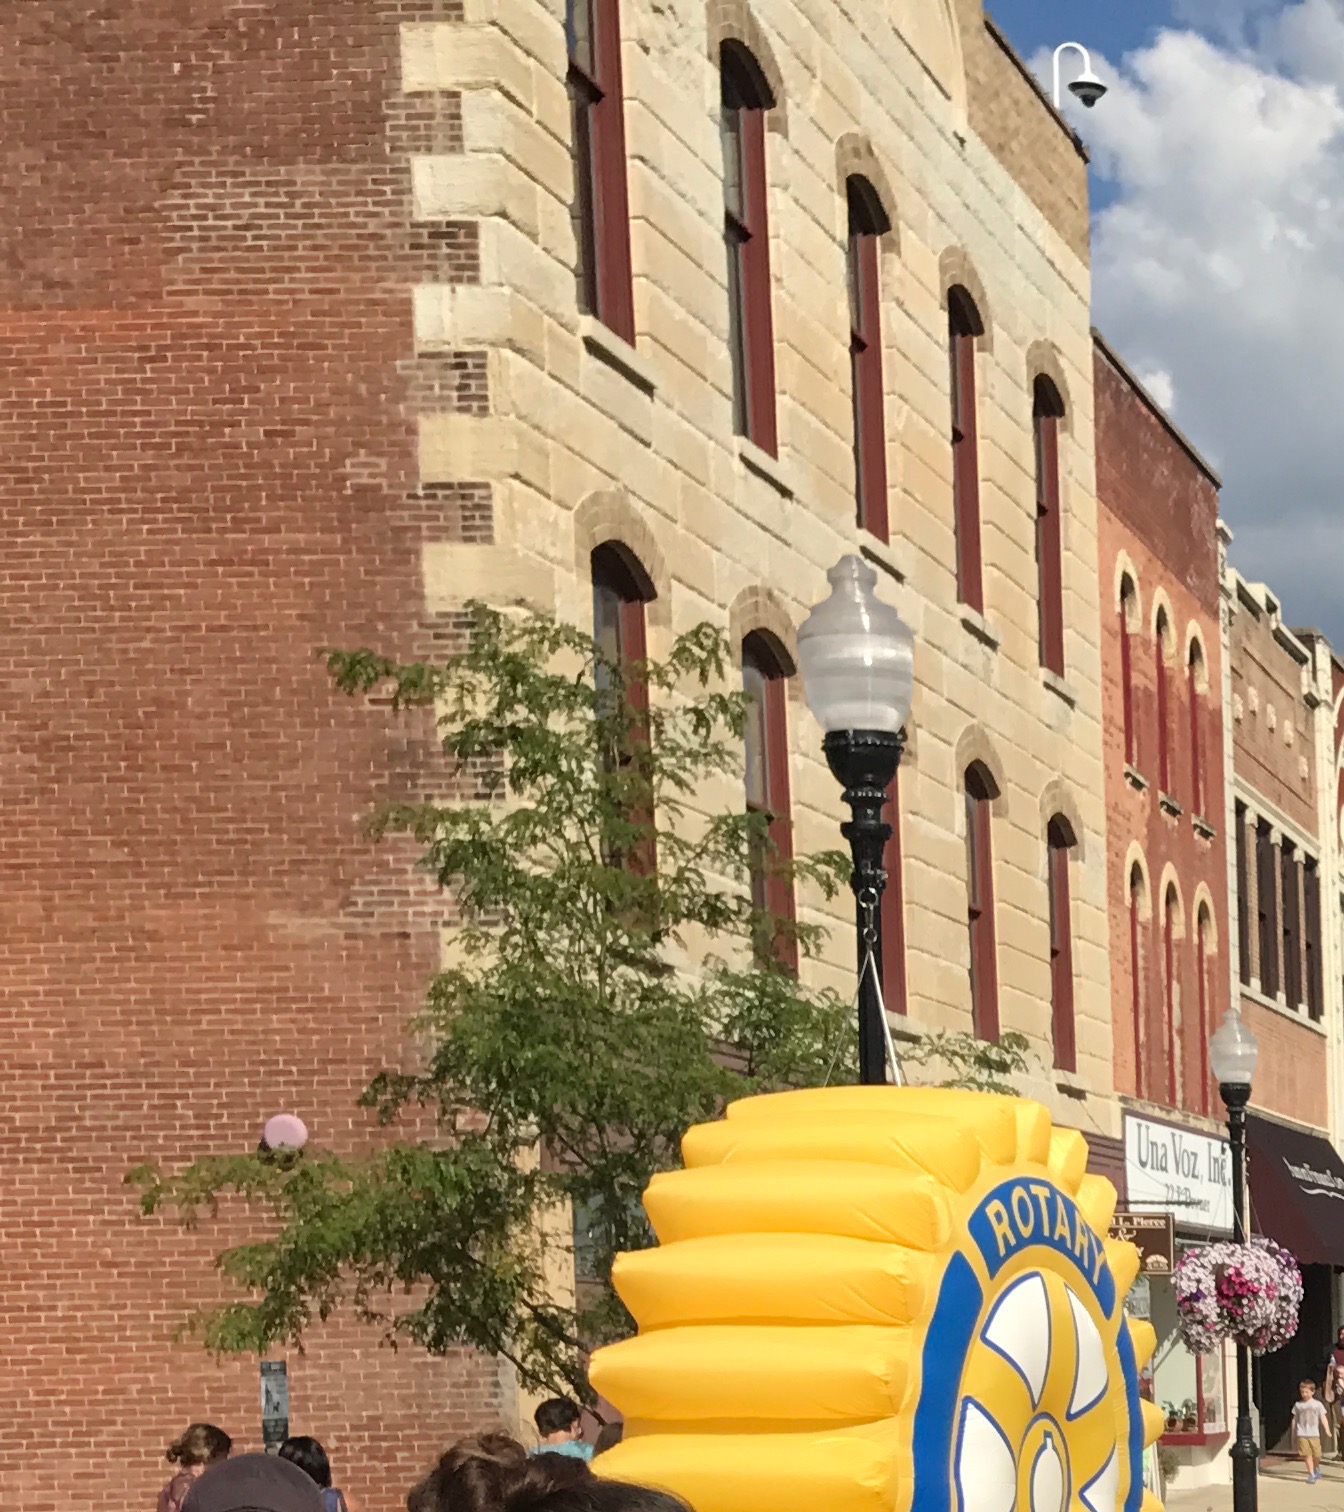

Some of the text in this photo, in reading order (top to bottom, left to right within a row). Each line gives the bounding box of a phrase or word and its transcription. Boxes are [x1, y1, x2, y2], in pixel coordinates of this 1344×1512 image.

[1136, 1123, 1169, 1173] Una
[1171, 1132, 1204, 1184] Voz,
[985, 1184, 1107, 1286] ROTARY
